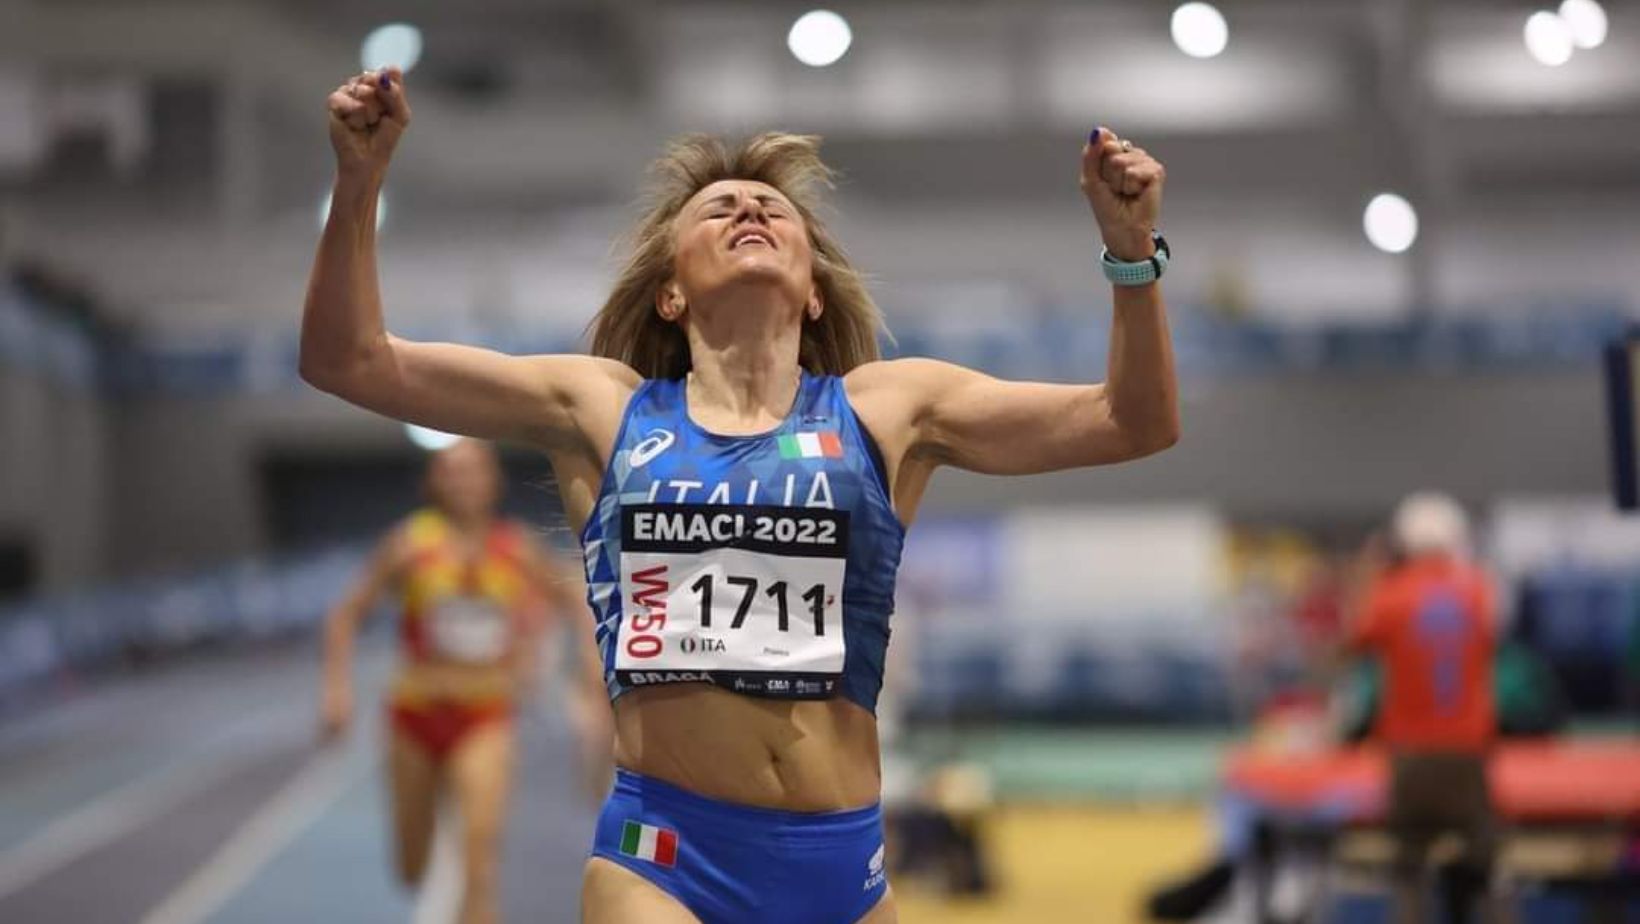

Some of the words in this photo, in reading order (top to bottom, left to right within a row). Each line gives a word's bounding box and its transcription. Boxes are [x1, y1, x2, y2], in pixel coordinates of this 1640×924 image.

[633, 512, 744, 541] EMACI
[754, 517, 837, 544] 2022
[626, 565, 669, 659] W50
[691, 574, 826, 637] 1711
[701, 638, 727, 652] ITA
